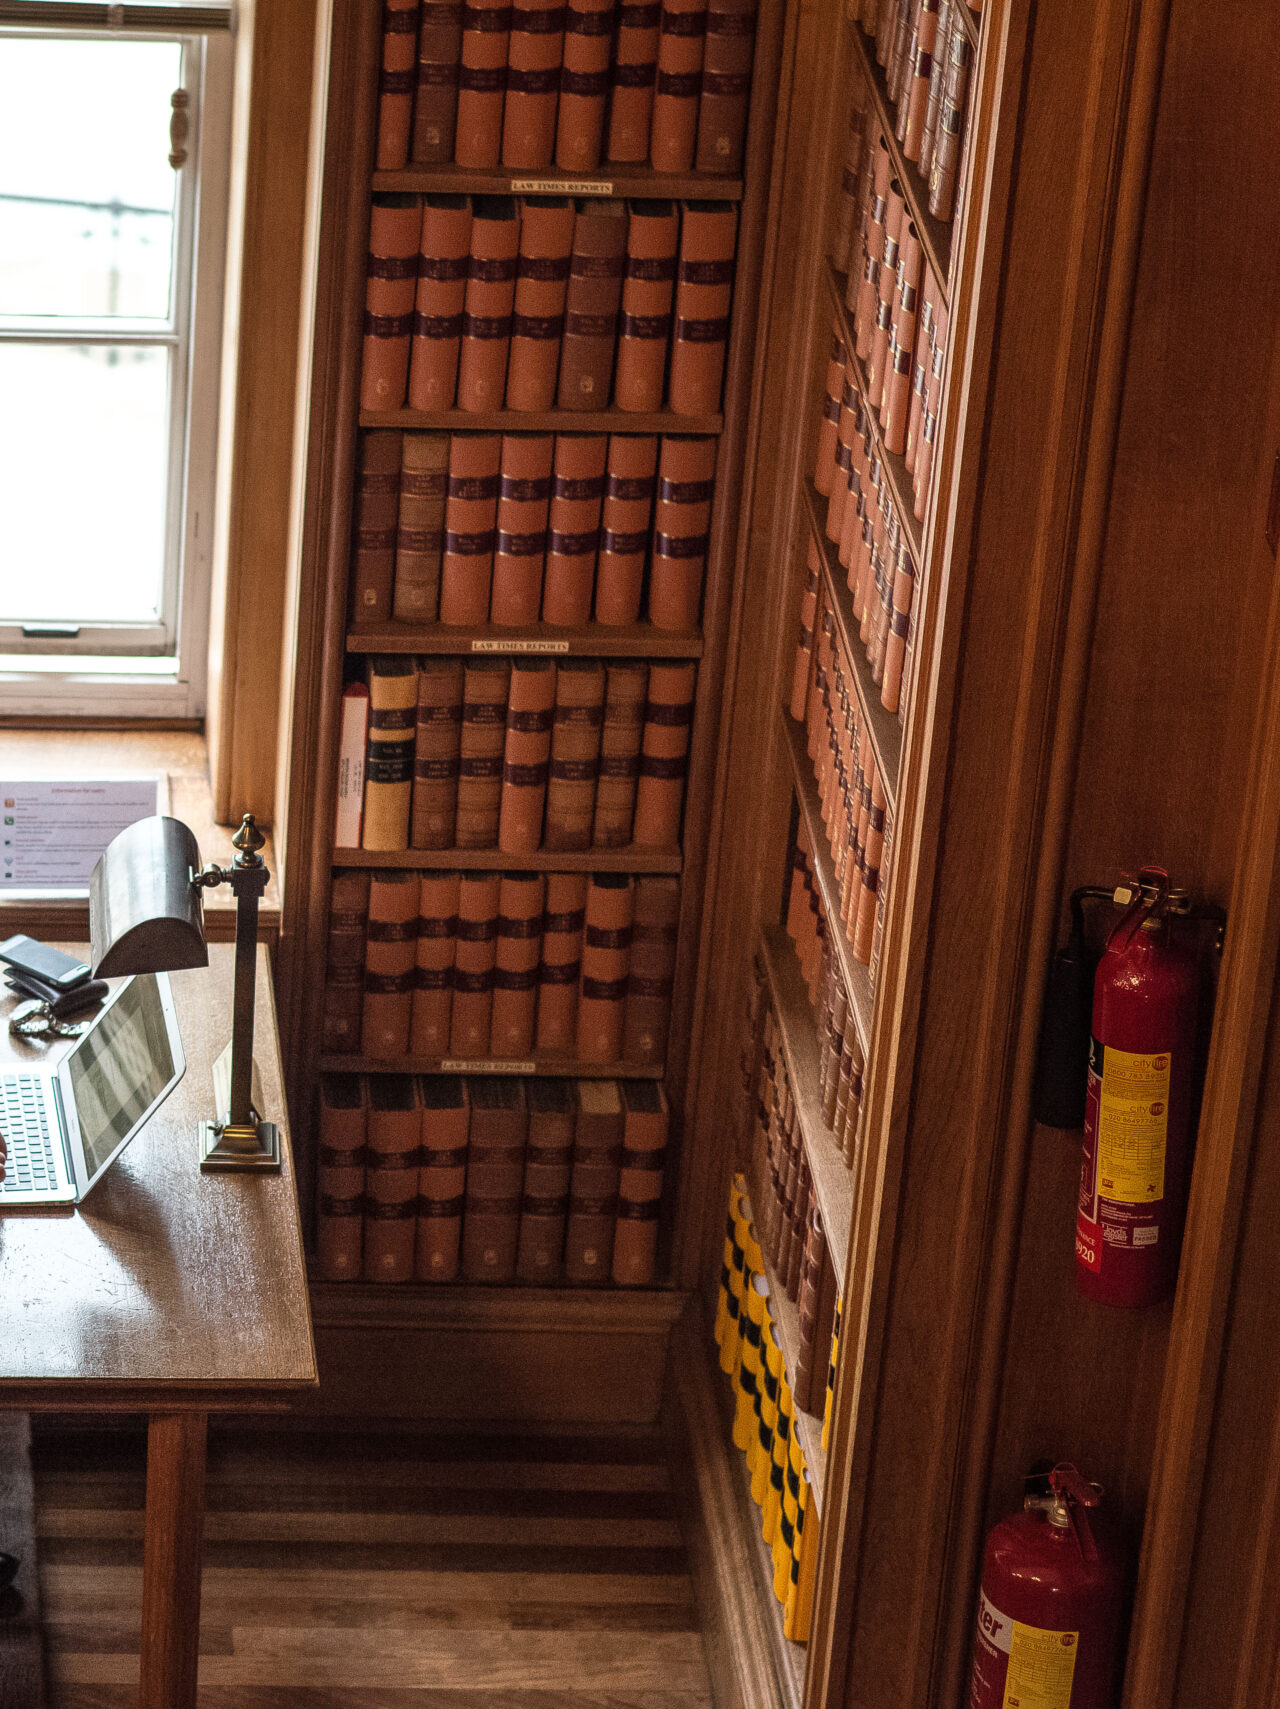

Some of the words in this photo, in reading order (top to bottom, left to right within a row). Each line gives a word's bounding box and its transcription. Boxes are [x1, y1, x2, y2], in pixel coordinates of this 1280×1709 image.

[513, 182, 533, 190] LAW
[538, 182, 565, 190] TIMES
[568, 183, 610, 192] REPORTS
[473, 642, 493, 650] LAW
[497, 642, 524, 650] TIMES
[526, 643, 567, 651] REPORTS
